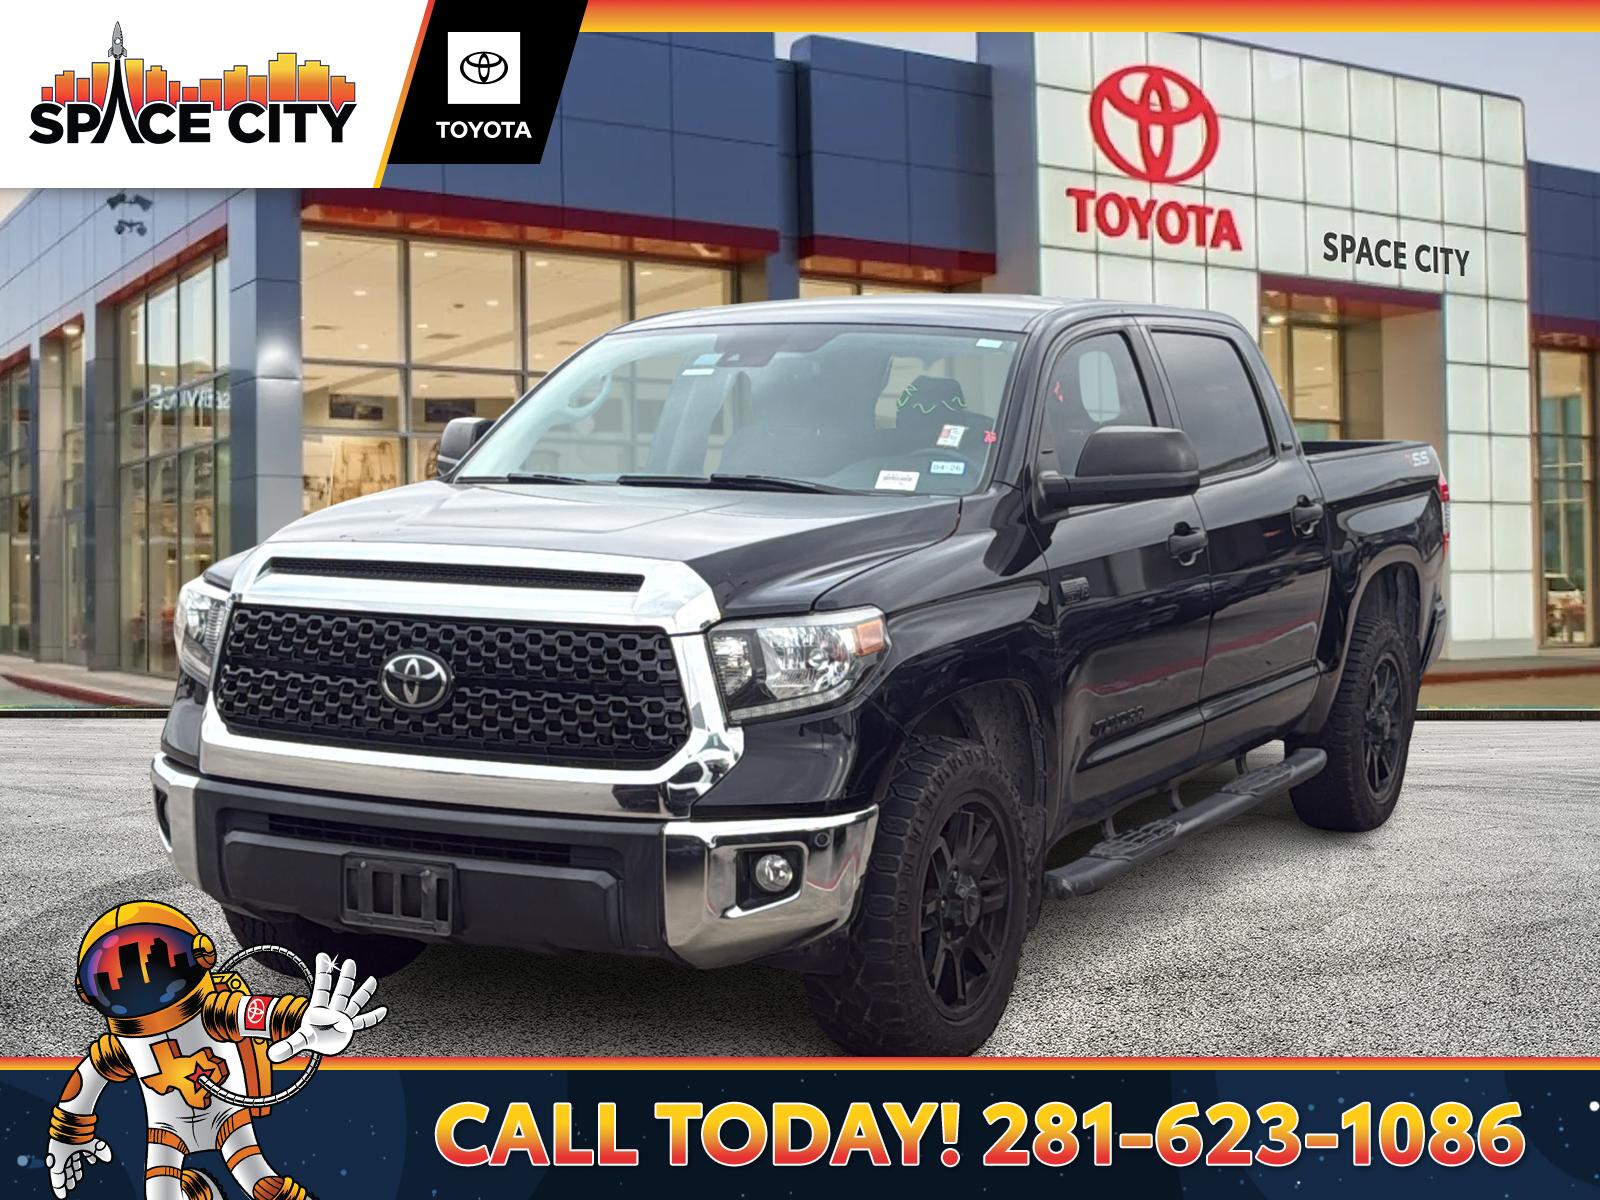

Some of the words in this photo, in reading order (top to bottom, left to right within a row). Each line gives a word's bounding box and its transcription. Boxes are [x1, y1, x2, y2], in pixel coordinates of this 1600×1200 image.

[1066, 188, 1243, 251] TOYOTA
[1323, 232, 1407, 270] SPACE
[1415, 244, 1470, 277] CITY
